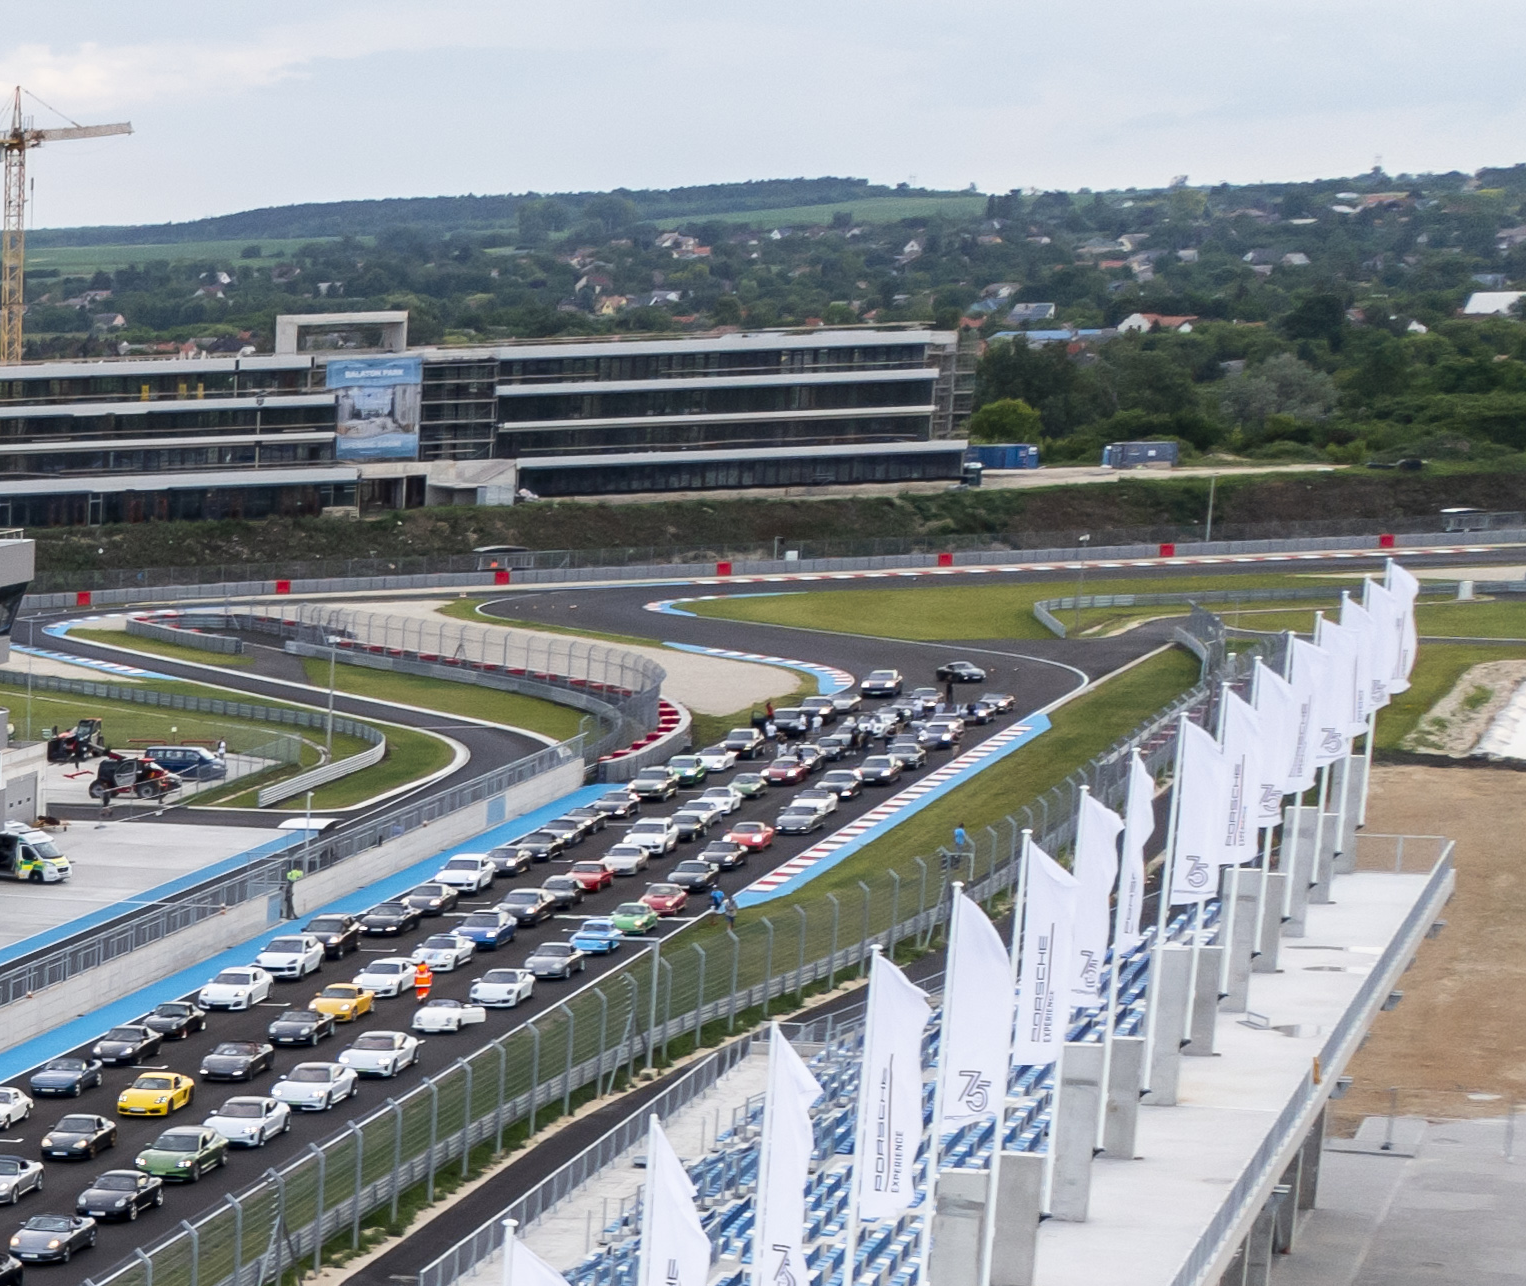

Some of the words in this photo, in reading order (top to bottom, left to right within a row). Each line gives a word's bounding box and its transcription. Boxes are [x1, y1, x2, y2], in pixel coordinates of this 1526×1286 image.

[1321, 727, 1342, 753] 75
[1185, 854, 1209, 888] 75
[1031, 935, 1048, 1042] PORSCHE
[957, 1070, 992, 1113] 75
[891, 1130, 904, 1193] EXPERIENCE
